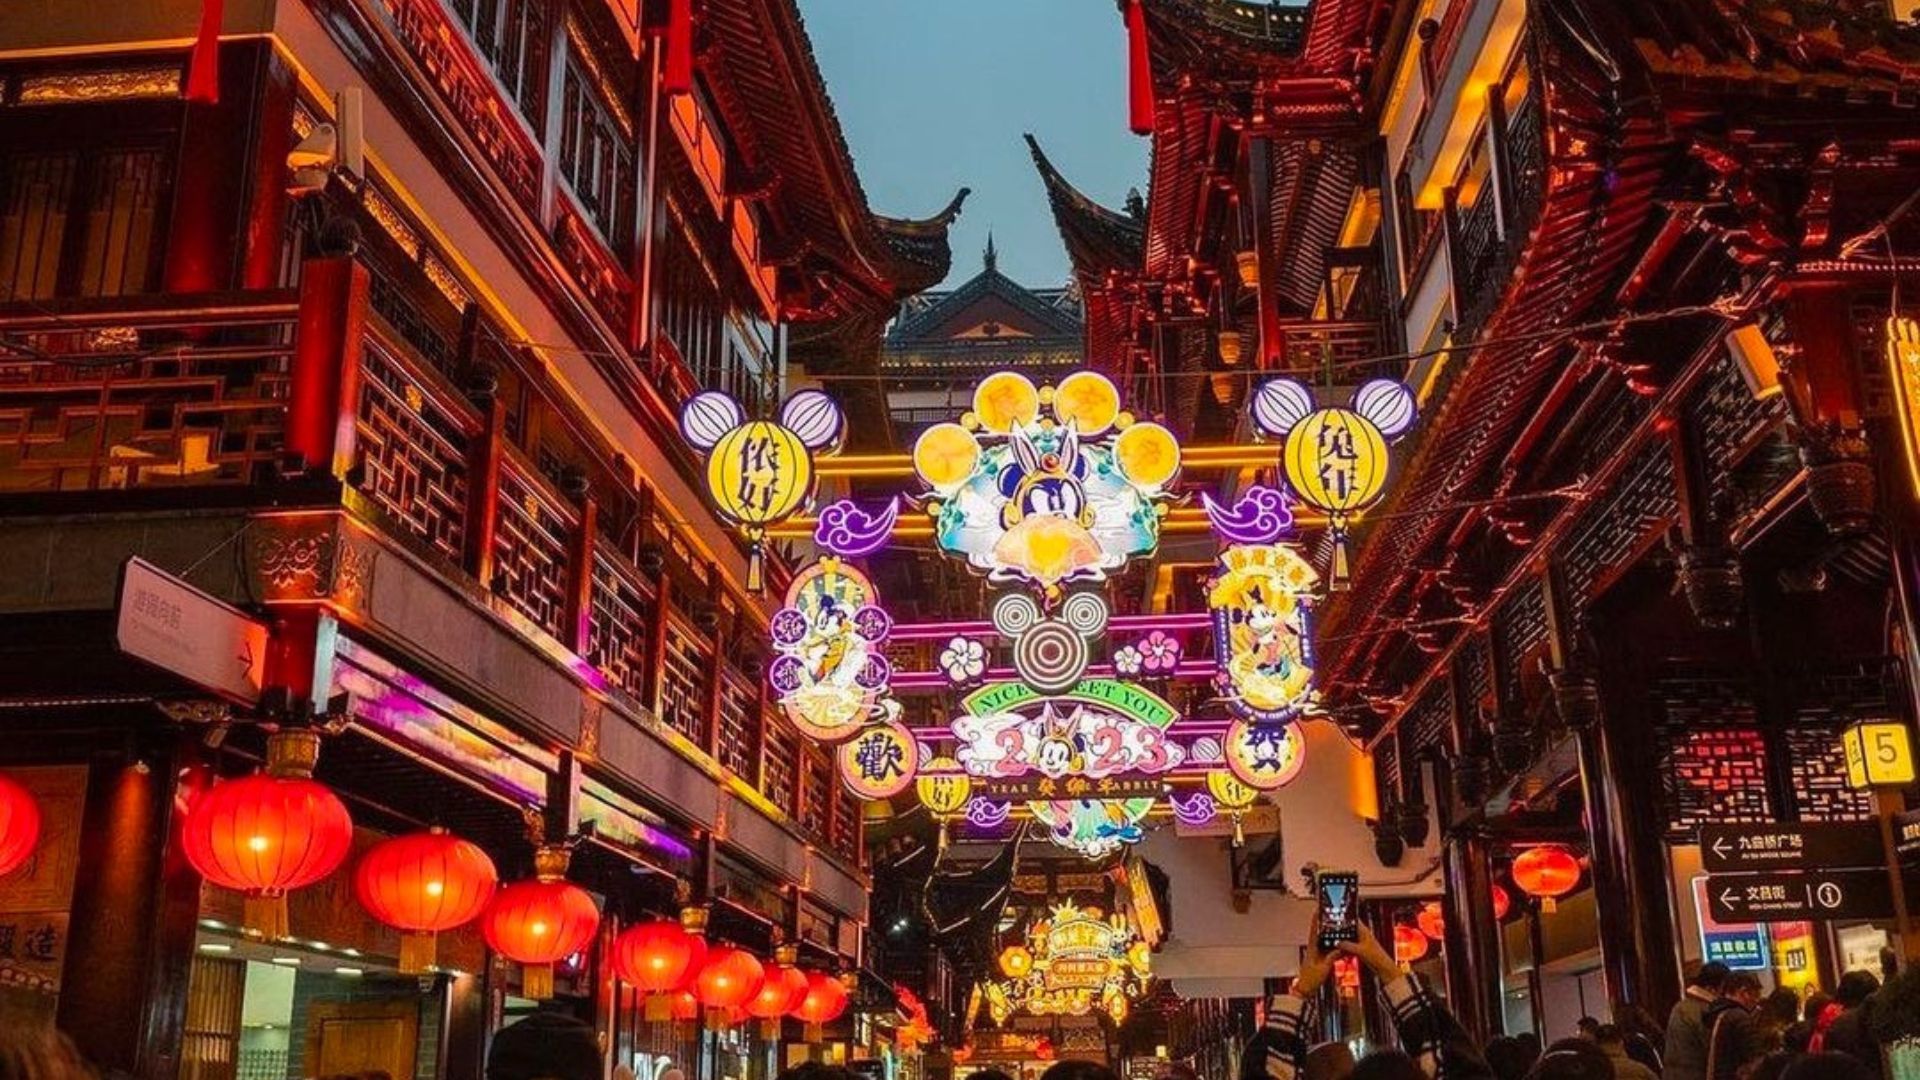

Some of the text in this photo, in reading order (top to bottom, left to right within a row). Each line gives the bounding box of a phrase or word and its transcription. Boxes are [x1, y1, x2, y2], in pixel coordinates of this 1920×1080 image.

[1318, 424, 1358, 500] 兔年
[980, 681, 1163, 719] NICE EET YOU
[856, 733, 907, 782] 歡
[996, 728, 1168, 773] 223
[1876, 732, 1898, 764] 5
[992, 780, 1159, 794] YEAR ABBIT
[1738, 834, 1804, 850] 九曲桥广场
[1746, 885, 1786, 901] 文昌街
